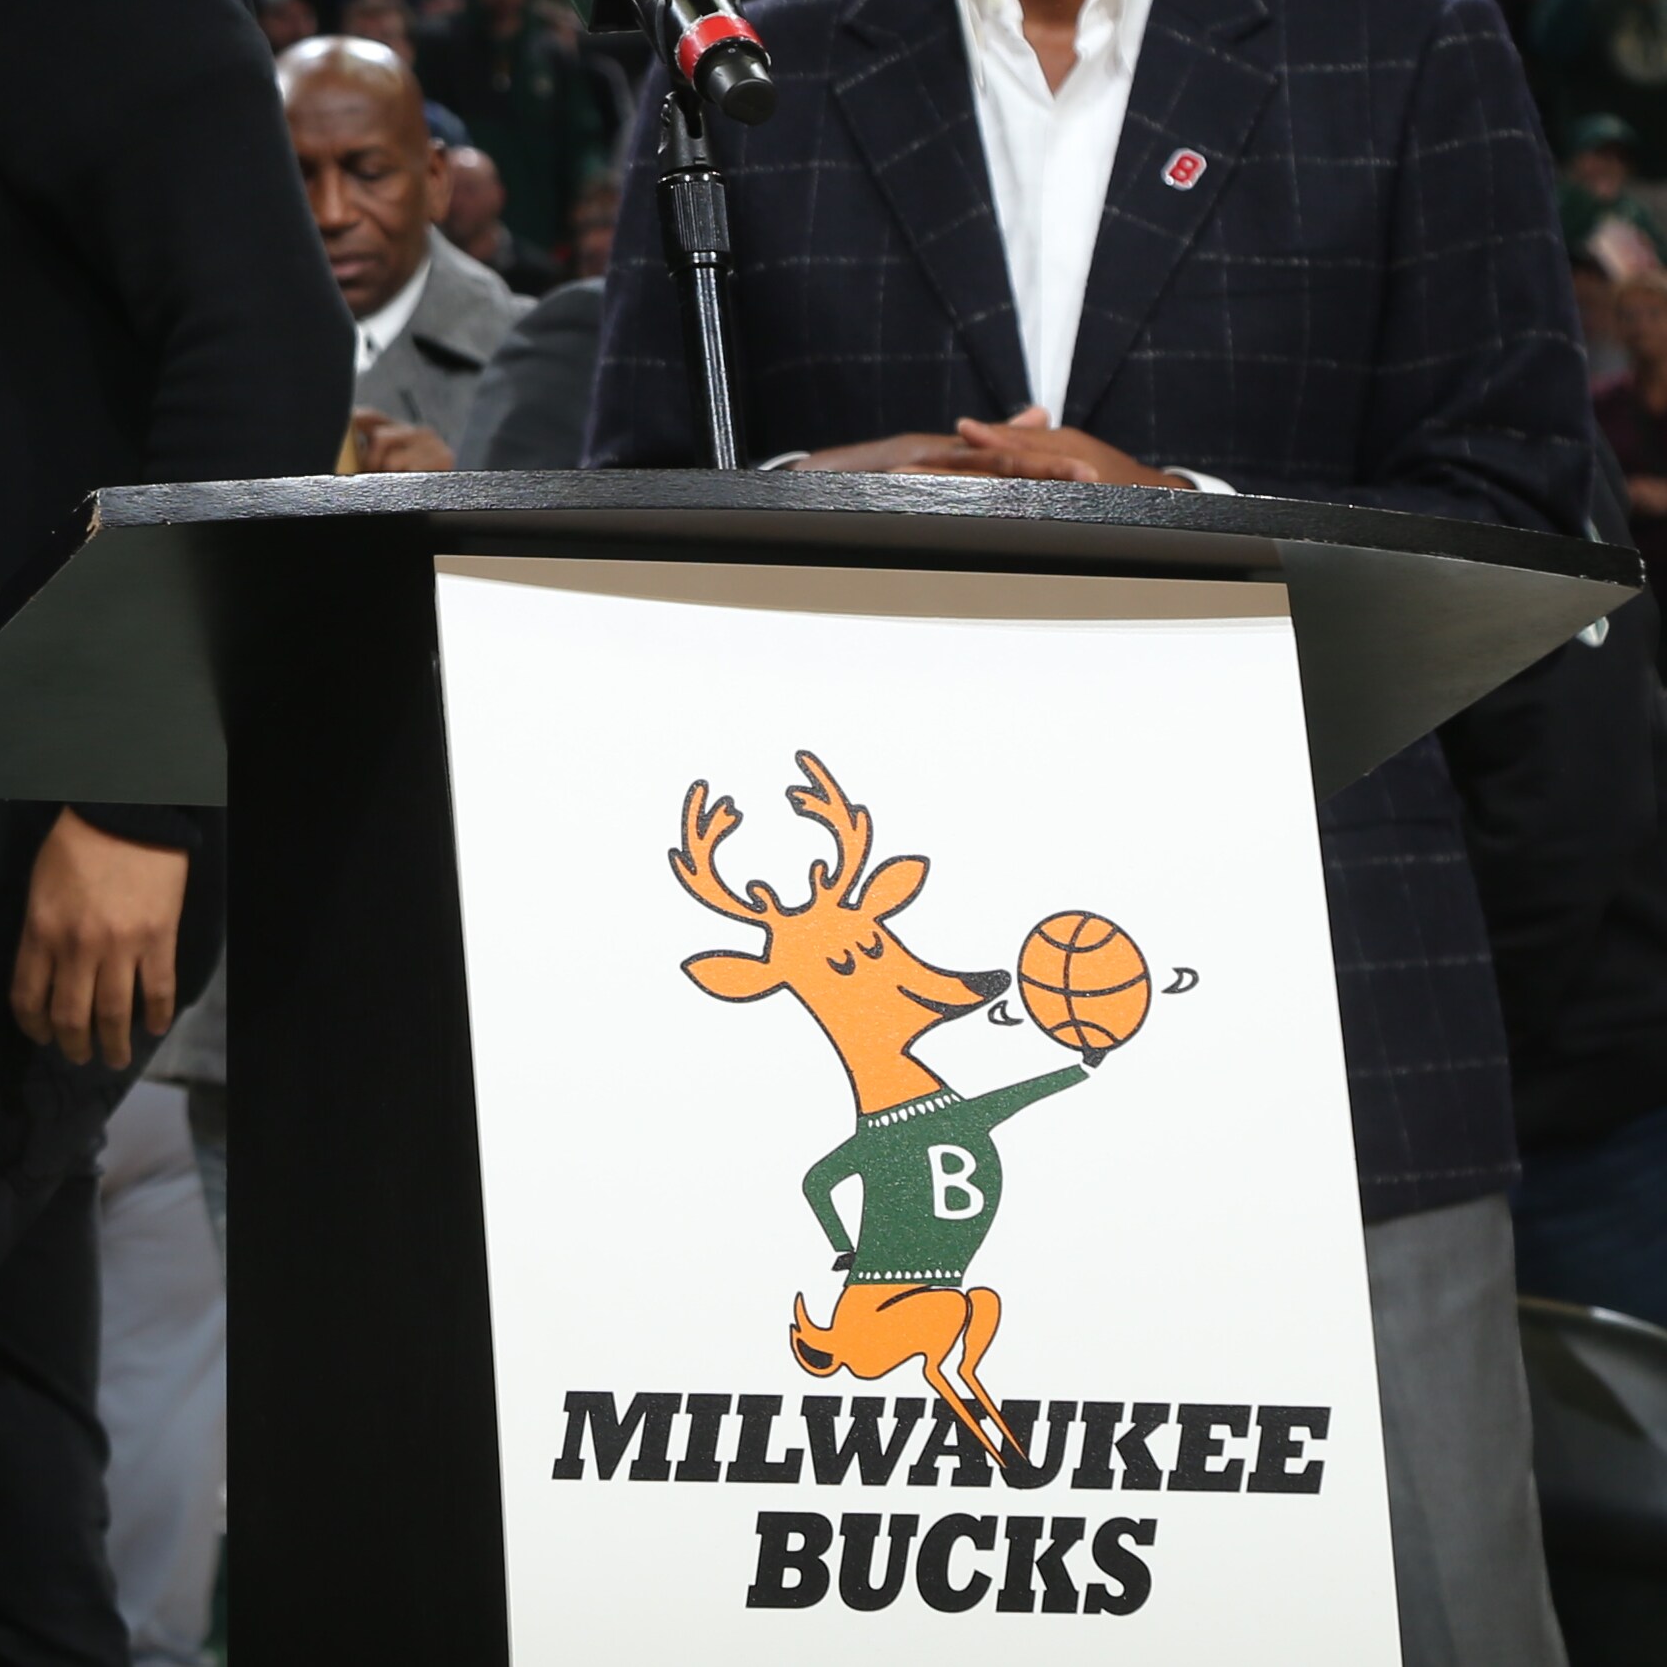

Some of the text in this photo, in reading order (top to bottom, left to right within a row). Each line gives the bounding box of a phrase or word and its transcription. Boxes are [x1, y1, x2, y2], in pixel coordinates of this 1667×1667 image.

[927, 1144, 985, 1220] B
[551, 1390, 1332, 1495] MILWAUKEE
[745, 1510, 1159, 1617] BUCKS
